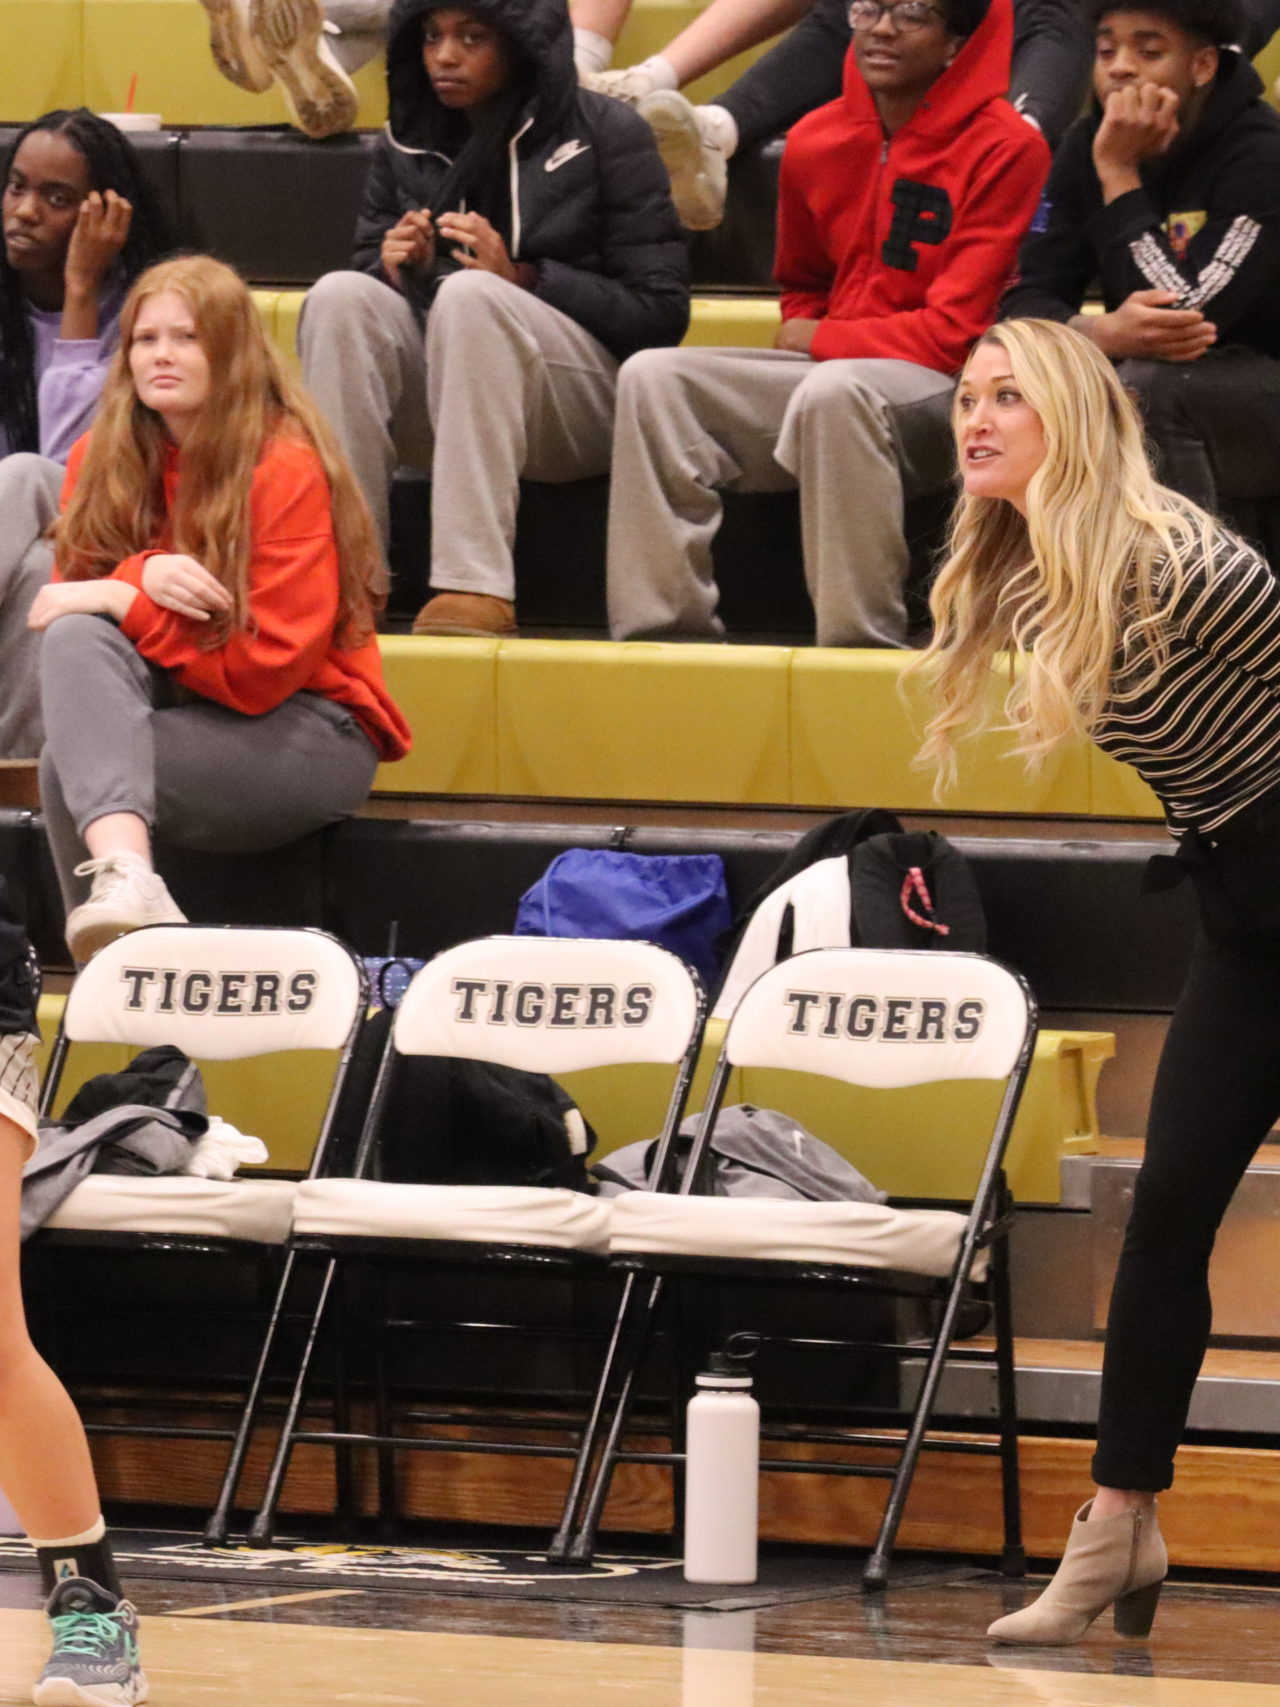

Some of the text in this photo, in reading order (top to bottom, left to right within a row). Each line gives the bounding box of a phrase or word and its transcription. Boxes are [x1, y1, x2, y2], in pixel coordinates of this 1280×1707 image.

[881, 178, 953, 272] P
[120, 965, 320, 1017] TIGERS
[450, 977, 657, 1029] TIGERS
[783, 988, 988, 1044] TIGERS
